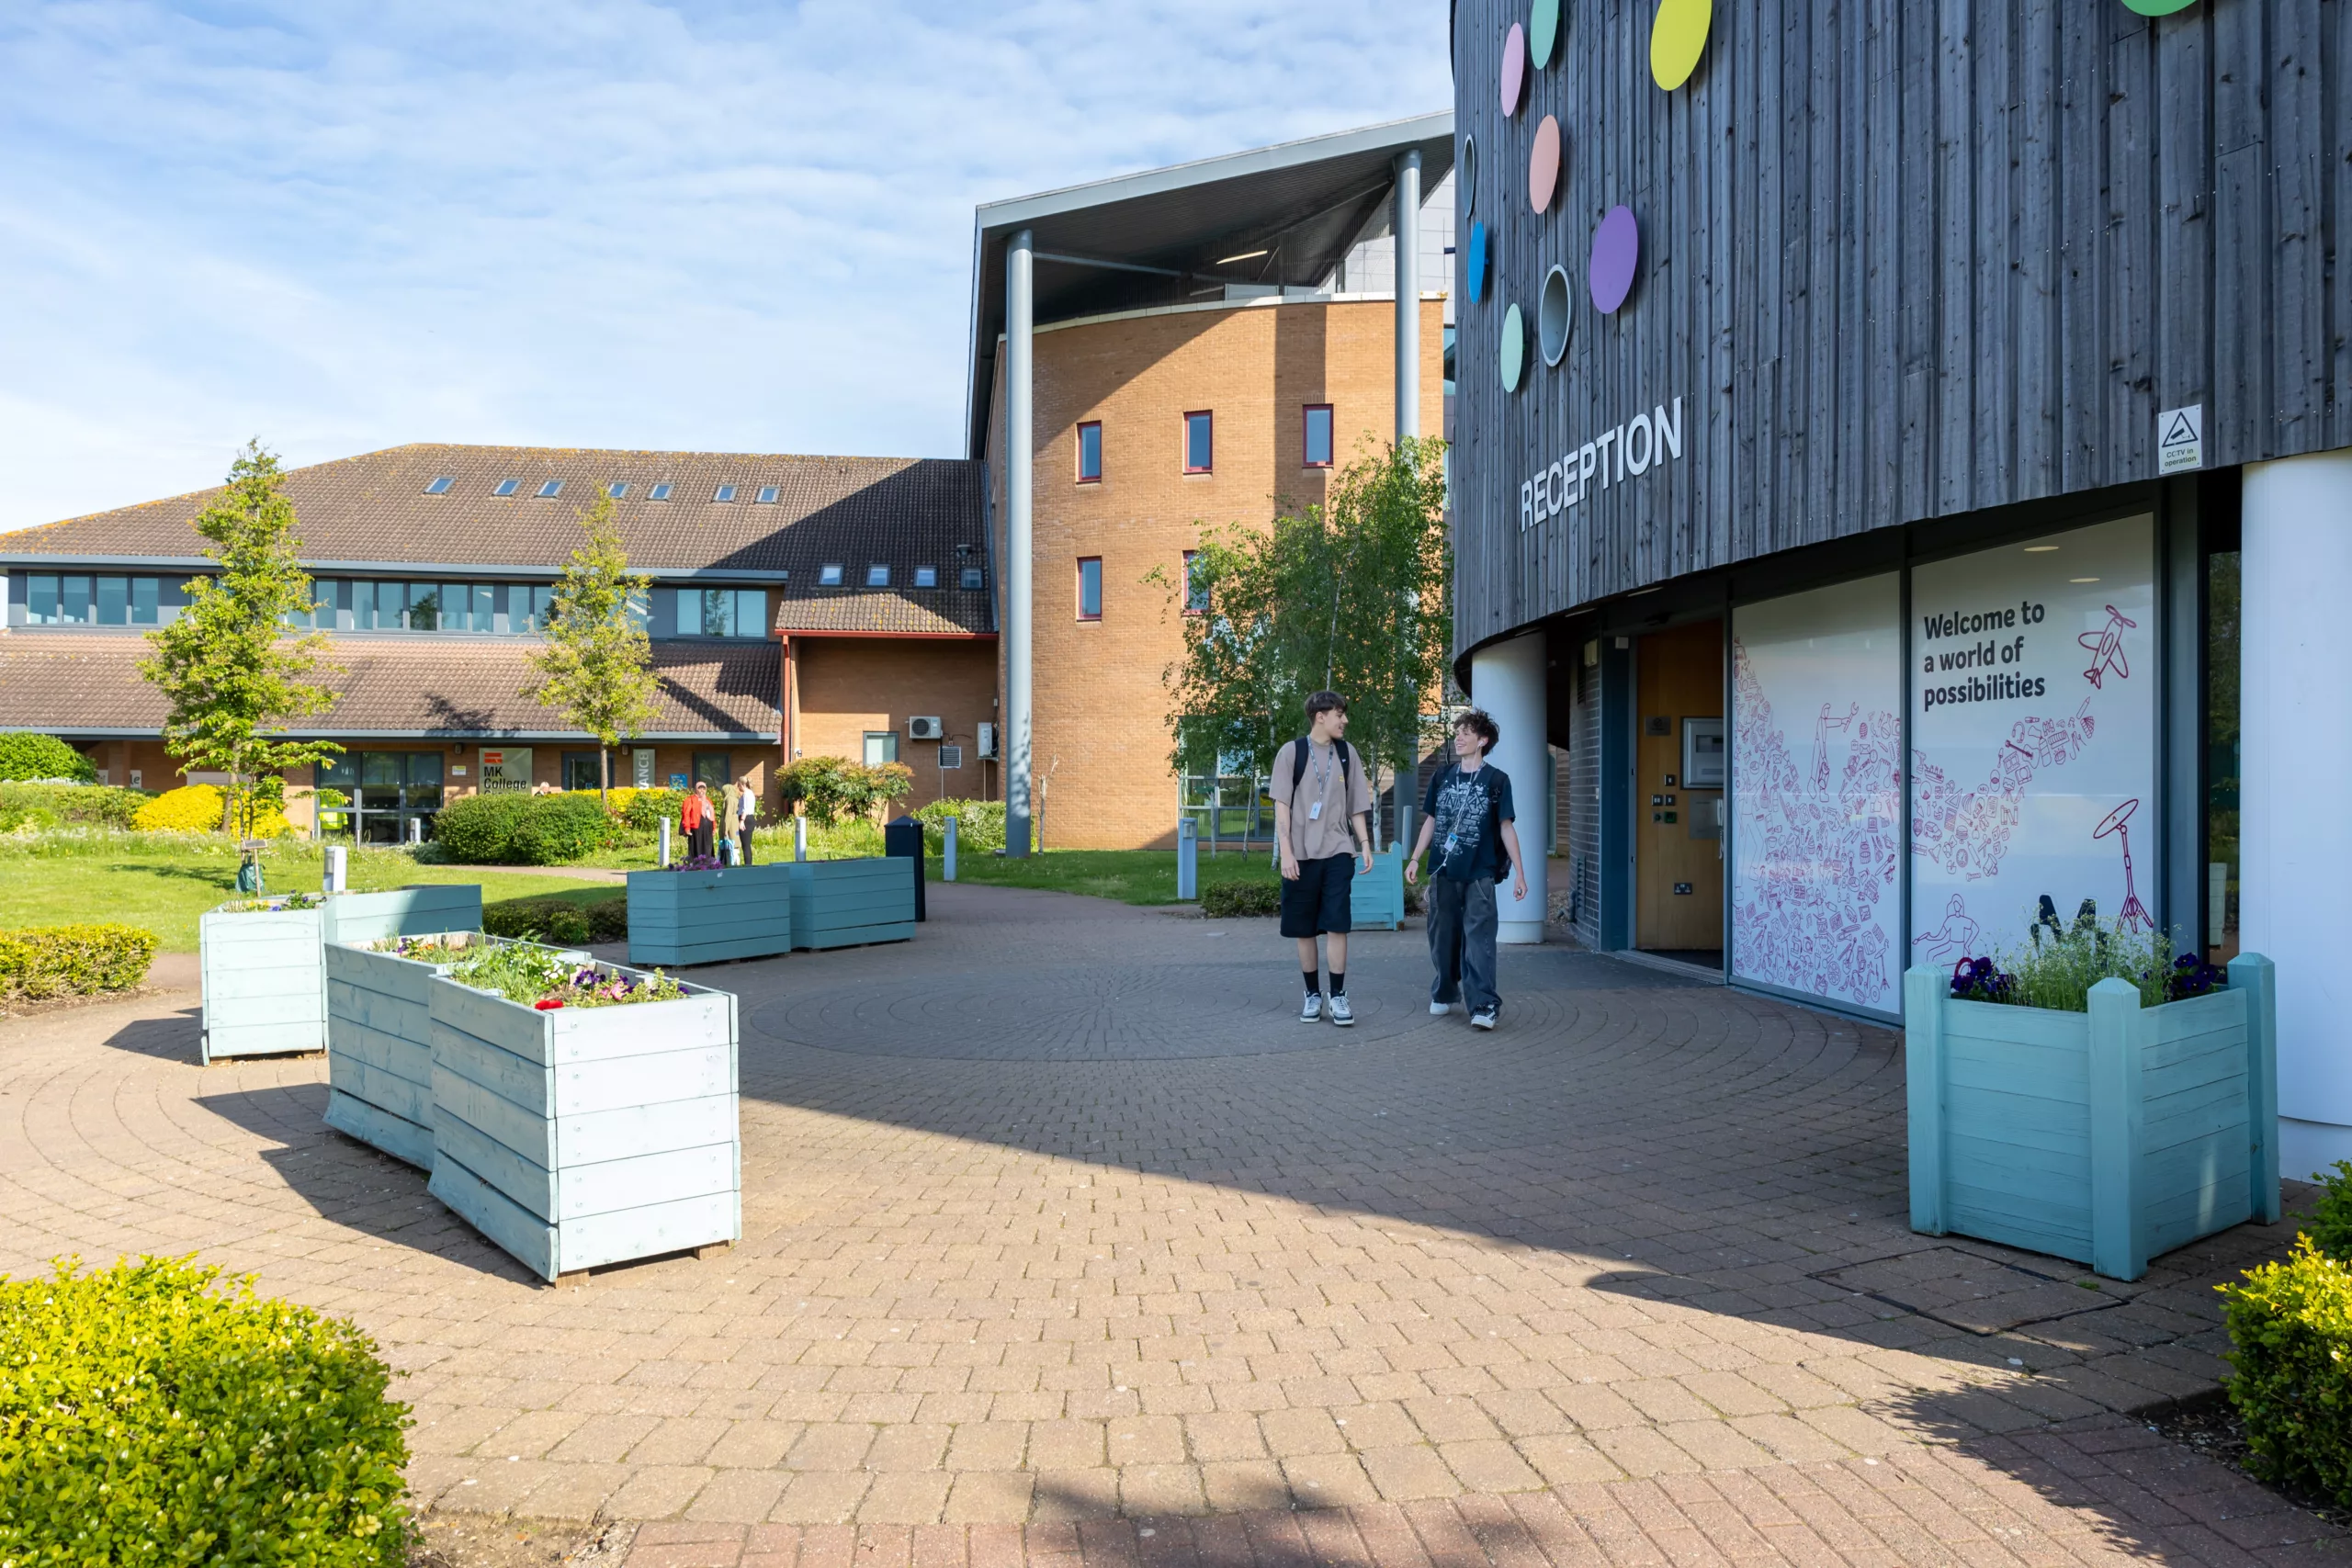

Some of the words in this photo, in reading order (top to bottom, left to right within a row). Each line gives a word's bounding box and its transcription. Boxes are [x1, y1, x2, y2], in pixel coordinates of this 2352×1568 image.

[1521, 397, 1681, 533] RECEPTION
[2165, 456, 2197, 468] operation
[2166, 449, 2186, 458] CCTV
[1924, 608, 2015, 639] Welcome
[2021, 601, 2045, 625] to
[1924, 655, 1934, 673] a
[1939, 640, 1995, 671] world
[2001, 636, 2025, 664] of
[1924, 671, 2045, 712] possibilities
[484, 766, 503, 777] MK
[484, 778, 527, 791] College
